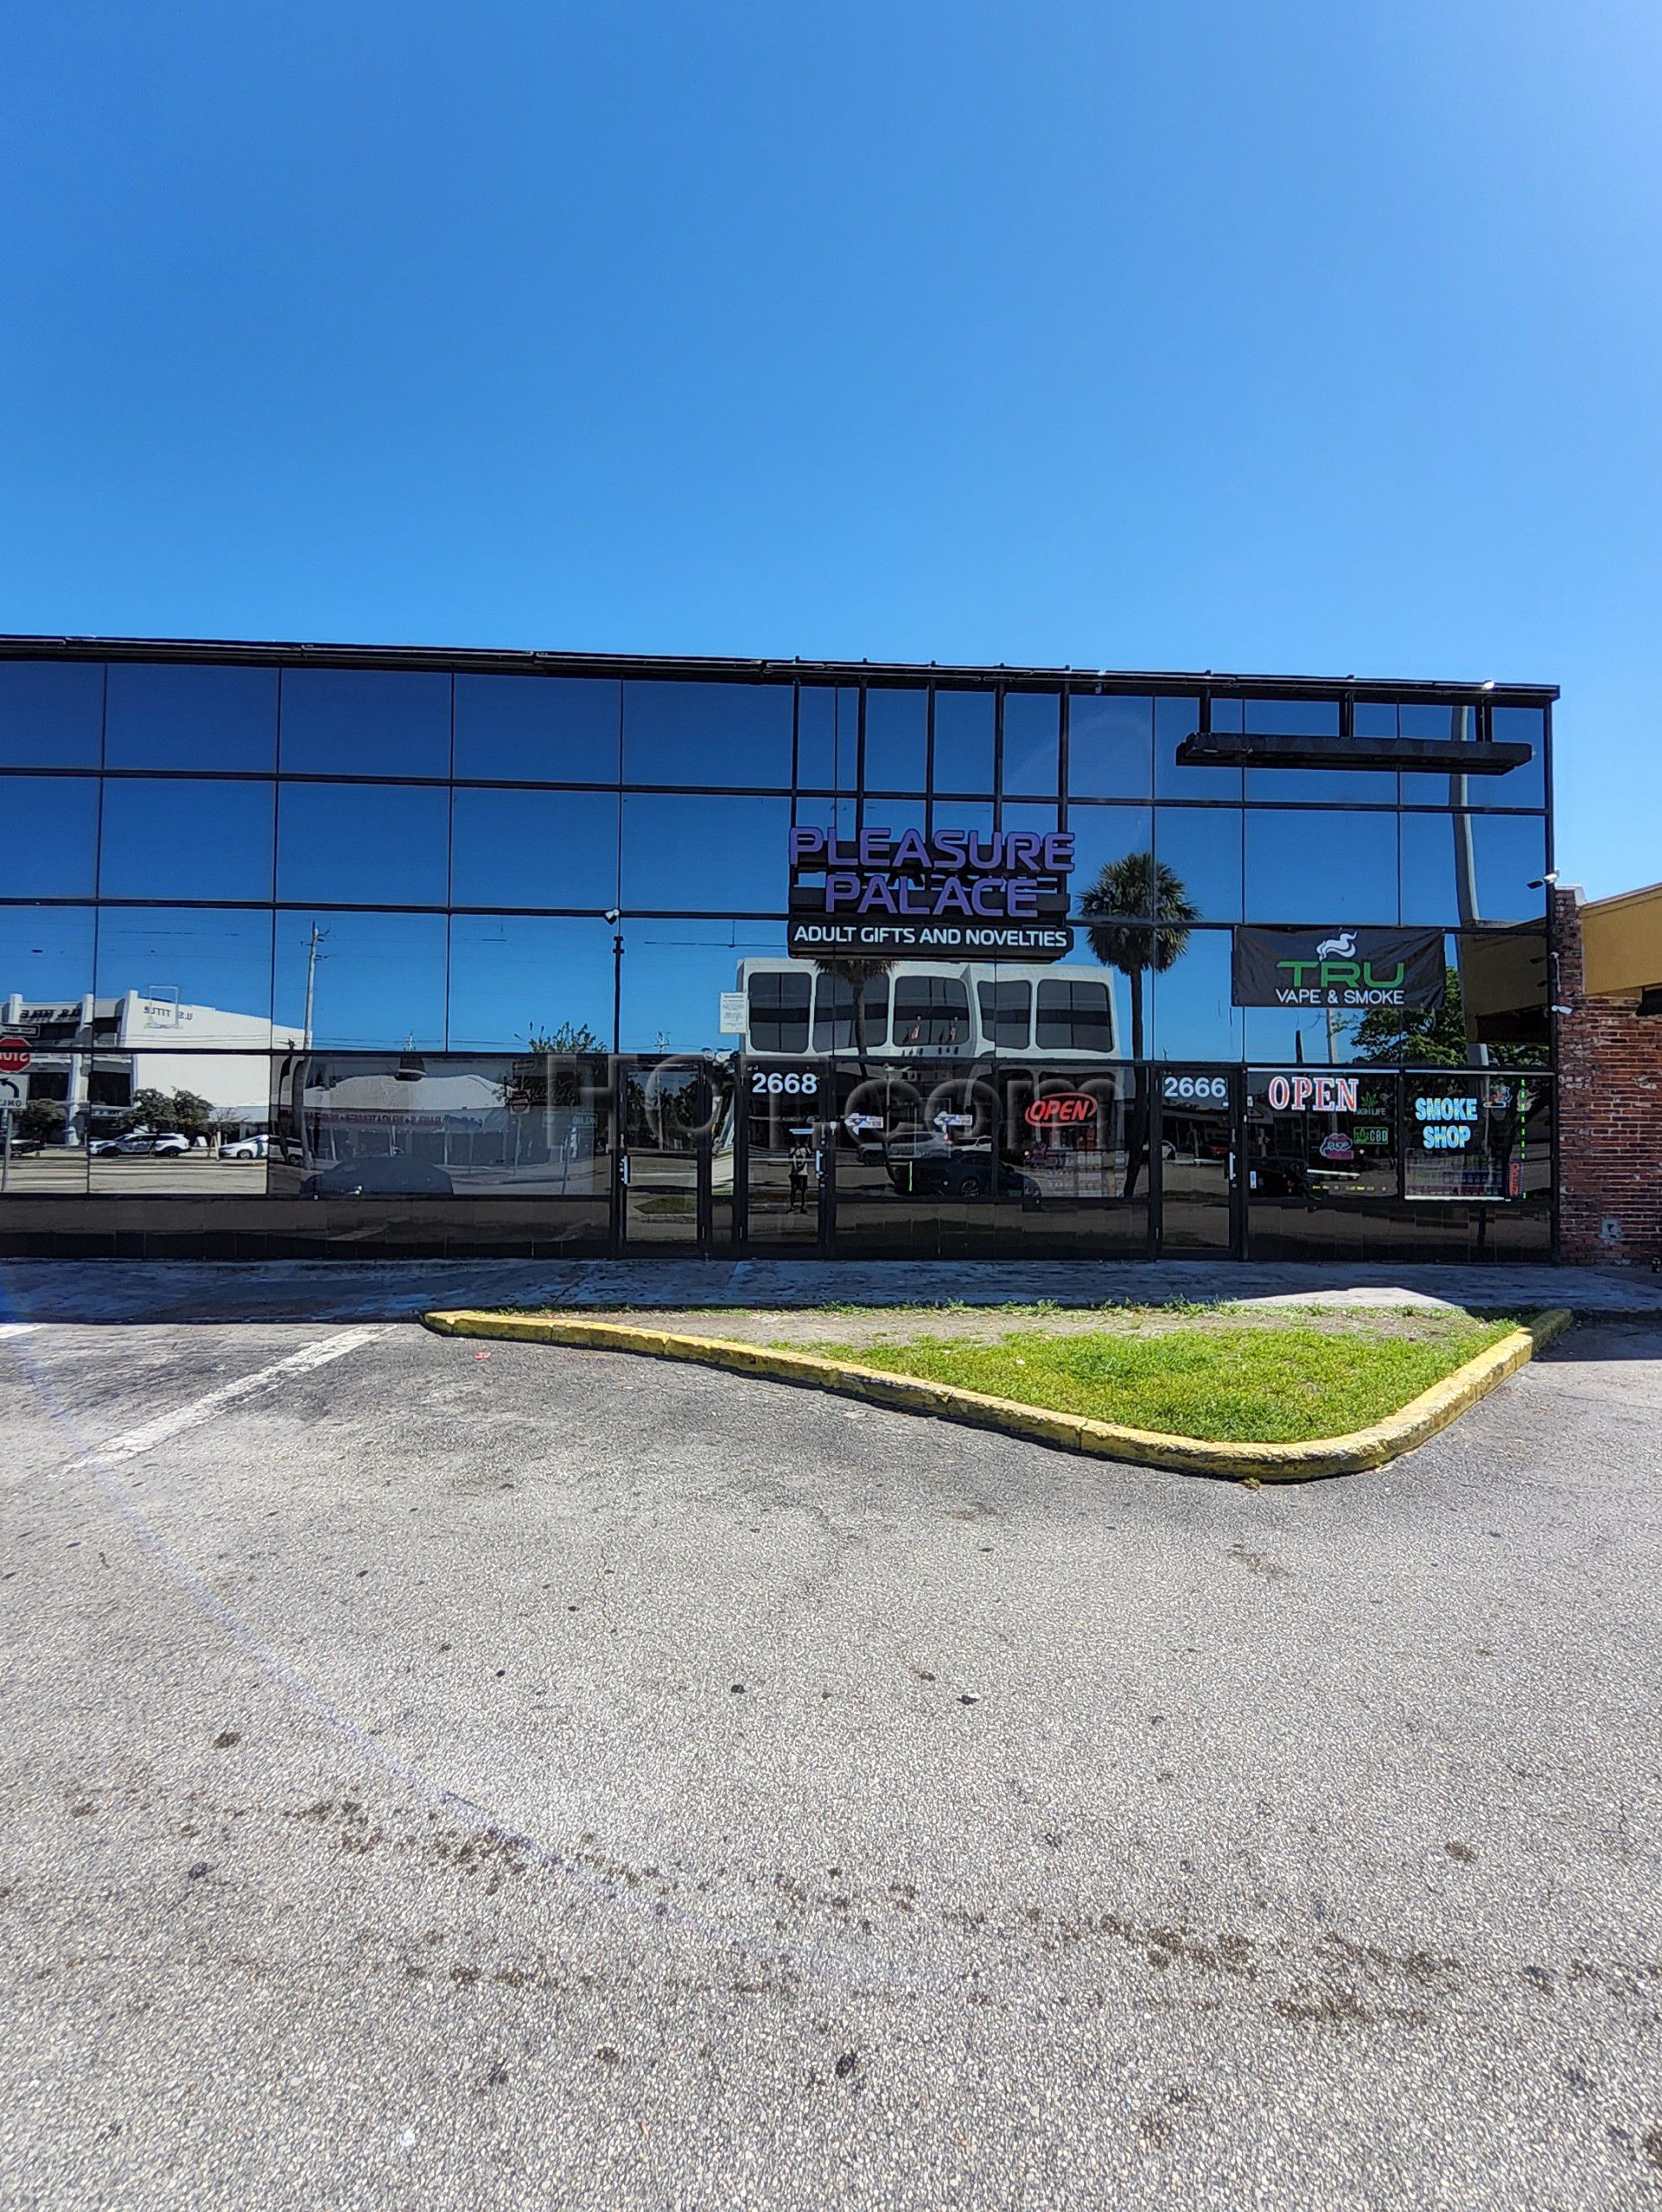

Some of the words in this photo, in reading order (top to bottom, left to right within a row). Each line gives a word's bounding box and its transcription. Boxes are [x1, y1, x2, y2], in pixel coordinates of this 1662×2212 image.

[789, 826, 1075, 872] PLEASURE
[825, 874, 1038, 918] PALACE
[793, 925, 856, 943] ADULT
[860, 927, 915, 944] GIFTS
[919, 928, 961, 945] AND
[965, 929, 1067, 947] NOVELTIES
[1277, 961, 1405, 988] TRU
[1276, 988, 1321, 1004] VAPE
[1327, 989, 1339, 1004] &
[1344, 989, 1405, 1004] SMOKE
[751, 1072, 818, 1095] 2668
[1164, 1077, 1227, 1097] 2666
[1269, 1076, 1360, 1112] OPEN
[1030, 1100, 1090, 1121] OPEN
[1415, 1097, 1478, 1121] SMOKE
[1369, 1129, 1388, 1142] CBD
[1423, 1125, 1471, 1149] SHOP
